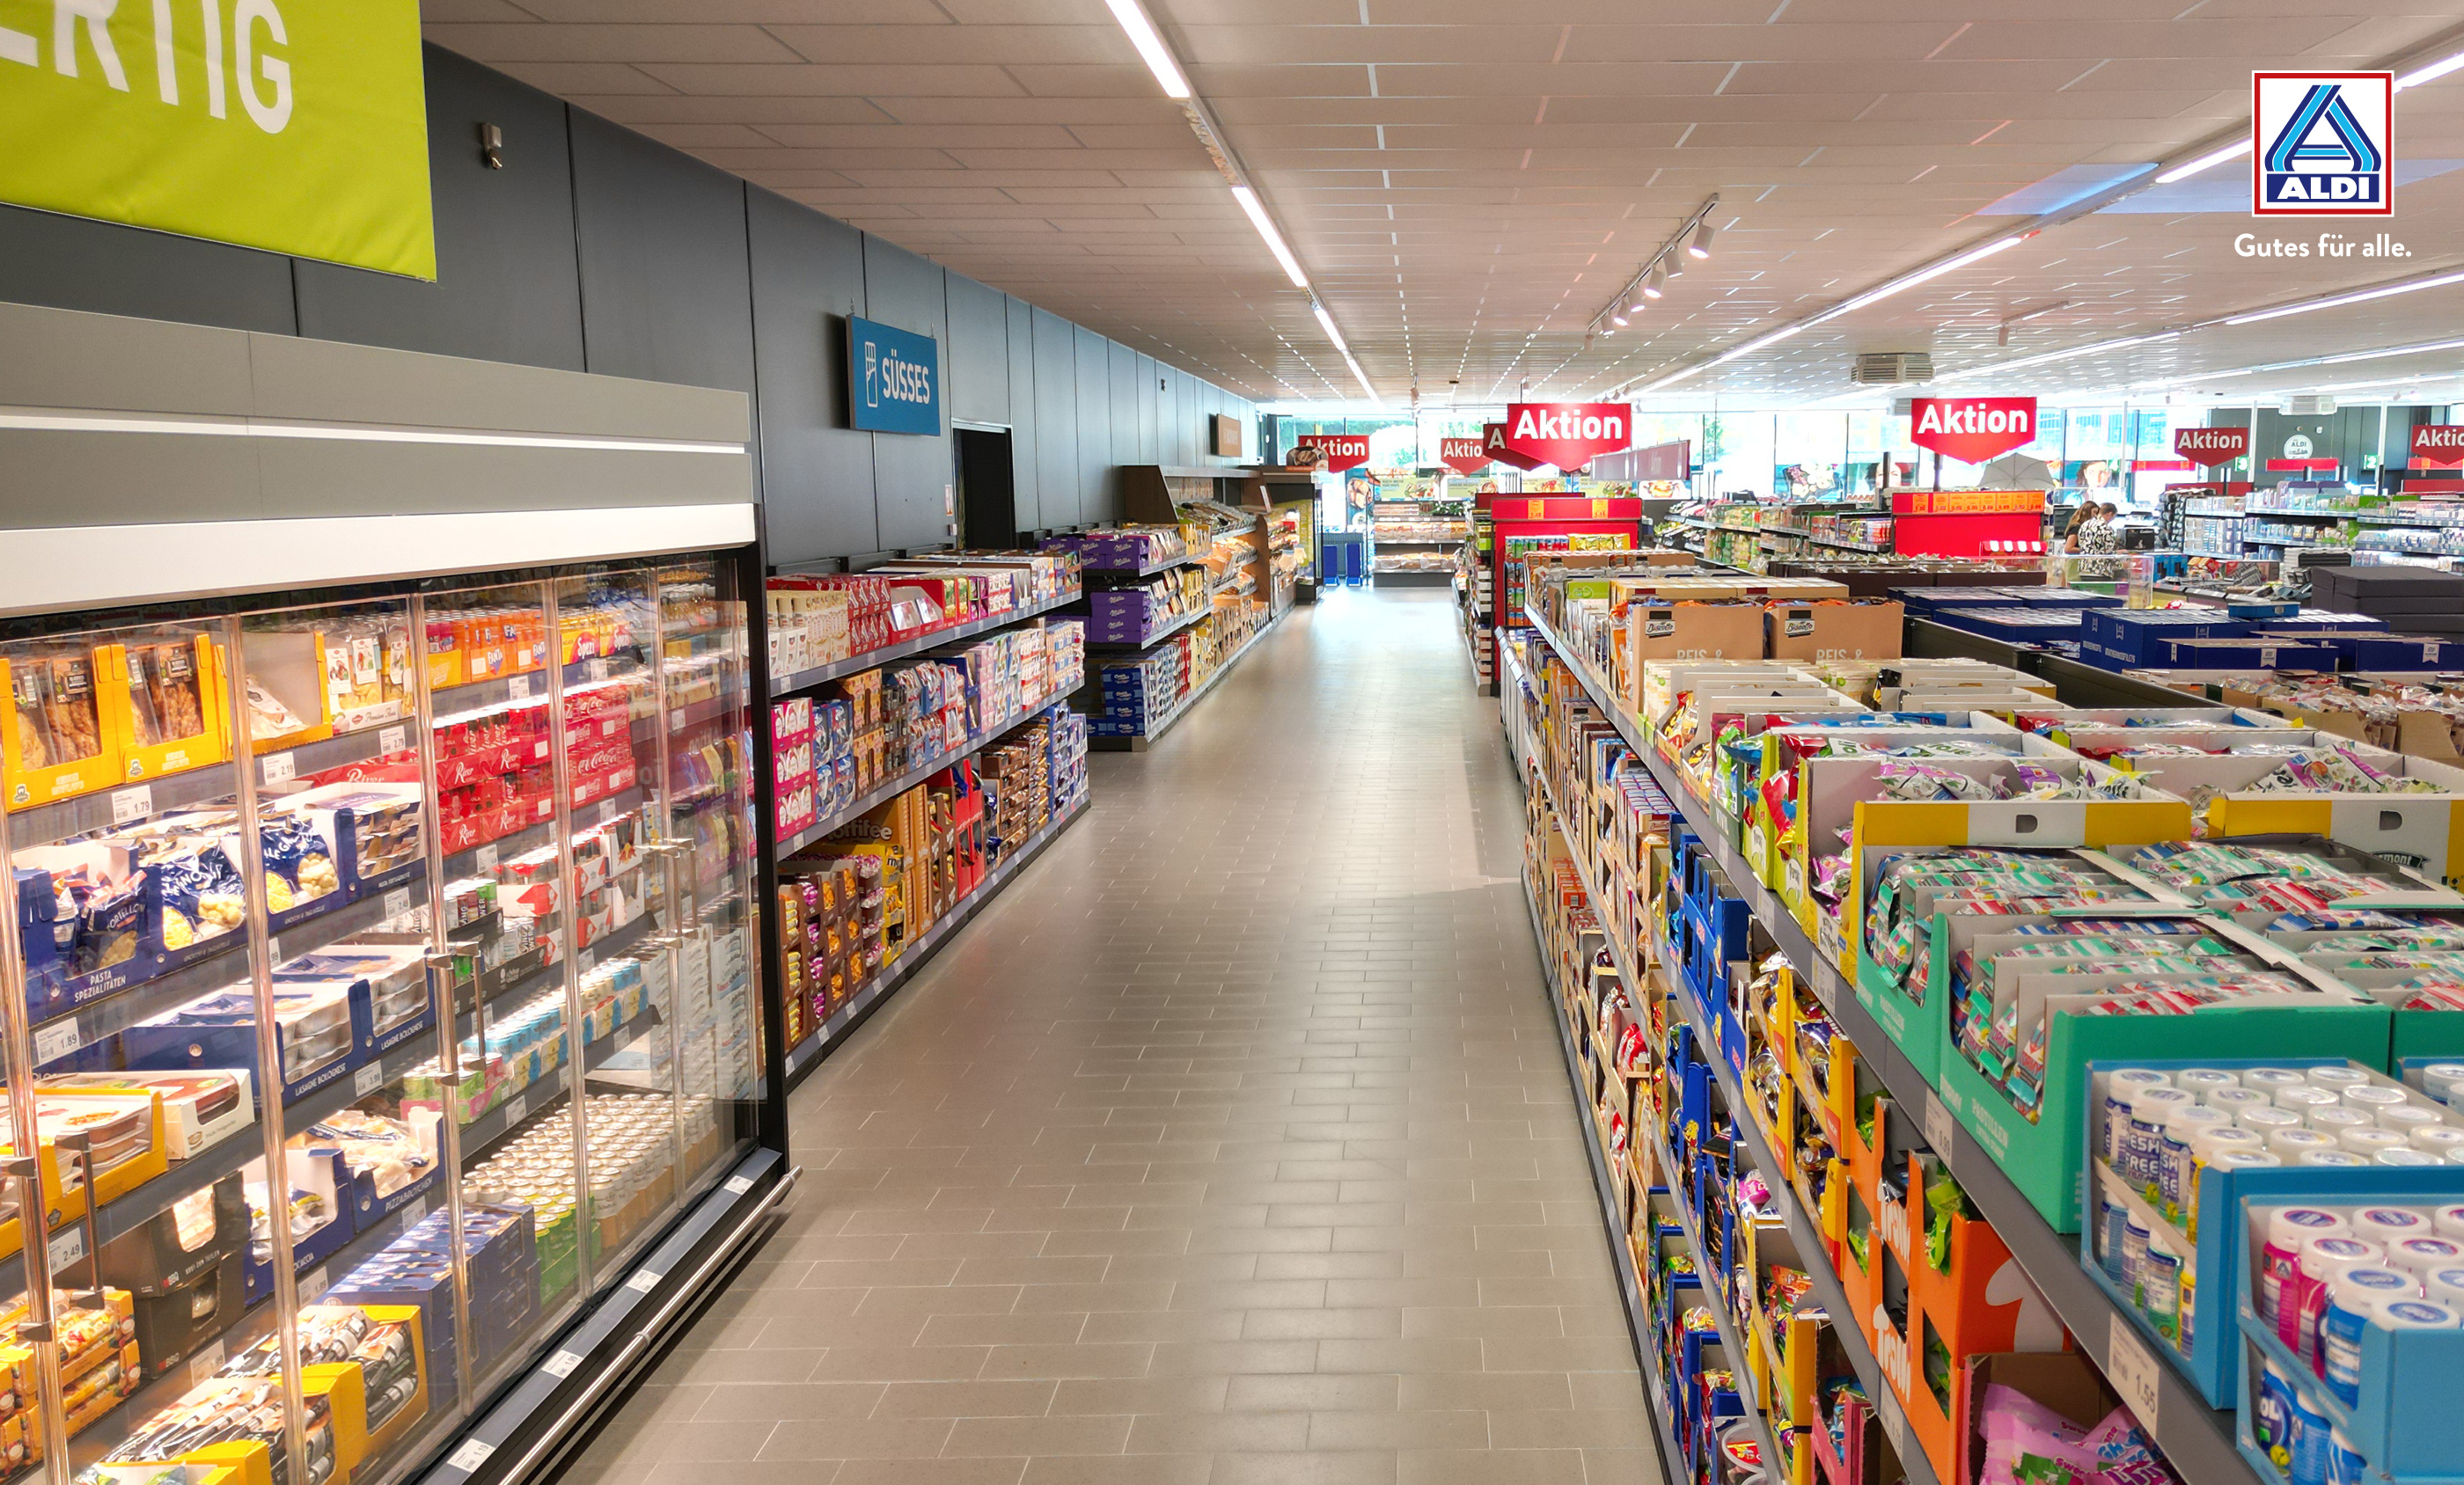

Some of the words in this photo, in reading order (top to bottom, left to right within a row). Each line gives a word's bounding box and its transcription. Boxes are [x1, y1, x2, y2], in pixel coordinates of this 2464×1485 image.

[883, 348, 930, 404] SÜSSES
[1514, 409, 1622, 439] Aktion
[1918, 403, 2028, 434] Aktion
[2177, 431, 2242, 449] Aktion
[2416, 428, 2464, 446] Aktio
[1443, 442, 1483, 457] Aktio
[2238, 457, 2248, 471] 3
[2367, 456, 2376, 468] 2
[1646, 624, 1674, 633] Biscotto
[1787, 623, 1814, 633] Biscotto
[577, 636, 595, 659] Spezi
[281, 764, 294, 775] 2.19
[454, 762, 474, 785] River
[134, 801, 150, 813] 1.79
[91, 970, 112, 985] PASTA
[75, 976, 126, 1003] SPEZIALITÄTEN
[61, 1033, 77, 1049] 1.89
[381, 1034, 400, 1050] LASAGNE
[296, 1079, 318, 1097] LASAGNE
[318, 1063, 346, 1083] BOLOGNESE
[2129, 1134, 2160, 1154] ESH
[63, 1244, 79, 1261] 2.49
[294, 1253, 314, 1272] OCACCIA
[2136, 1372, 2156, 1415] 1.55
